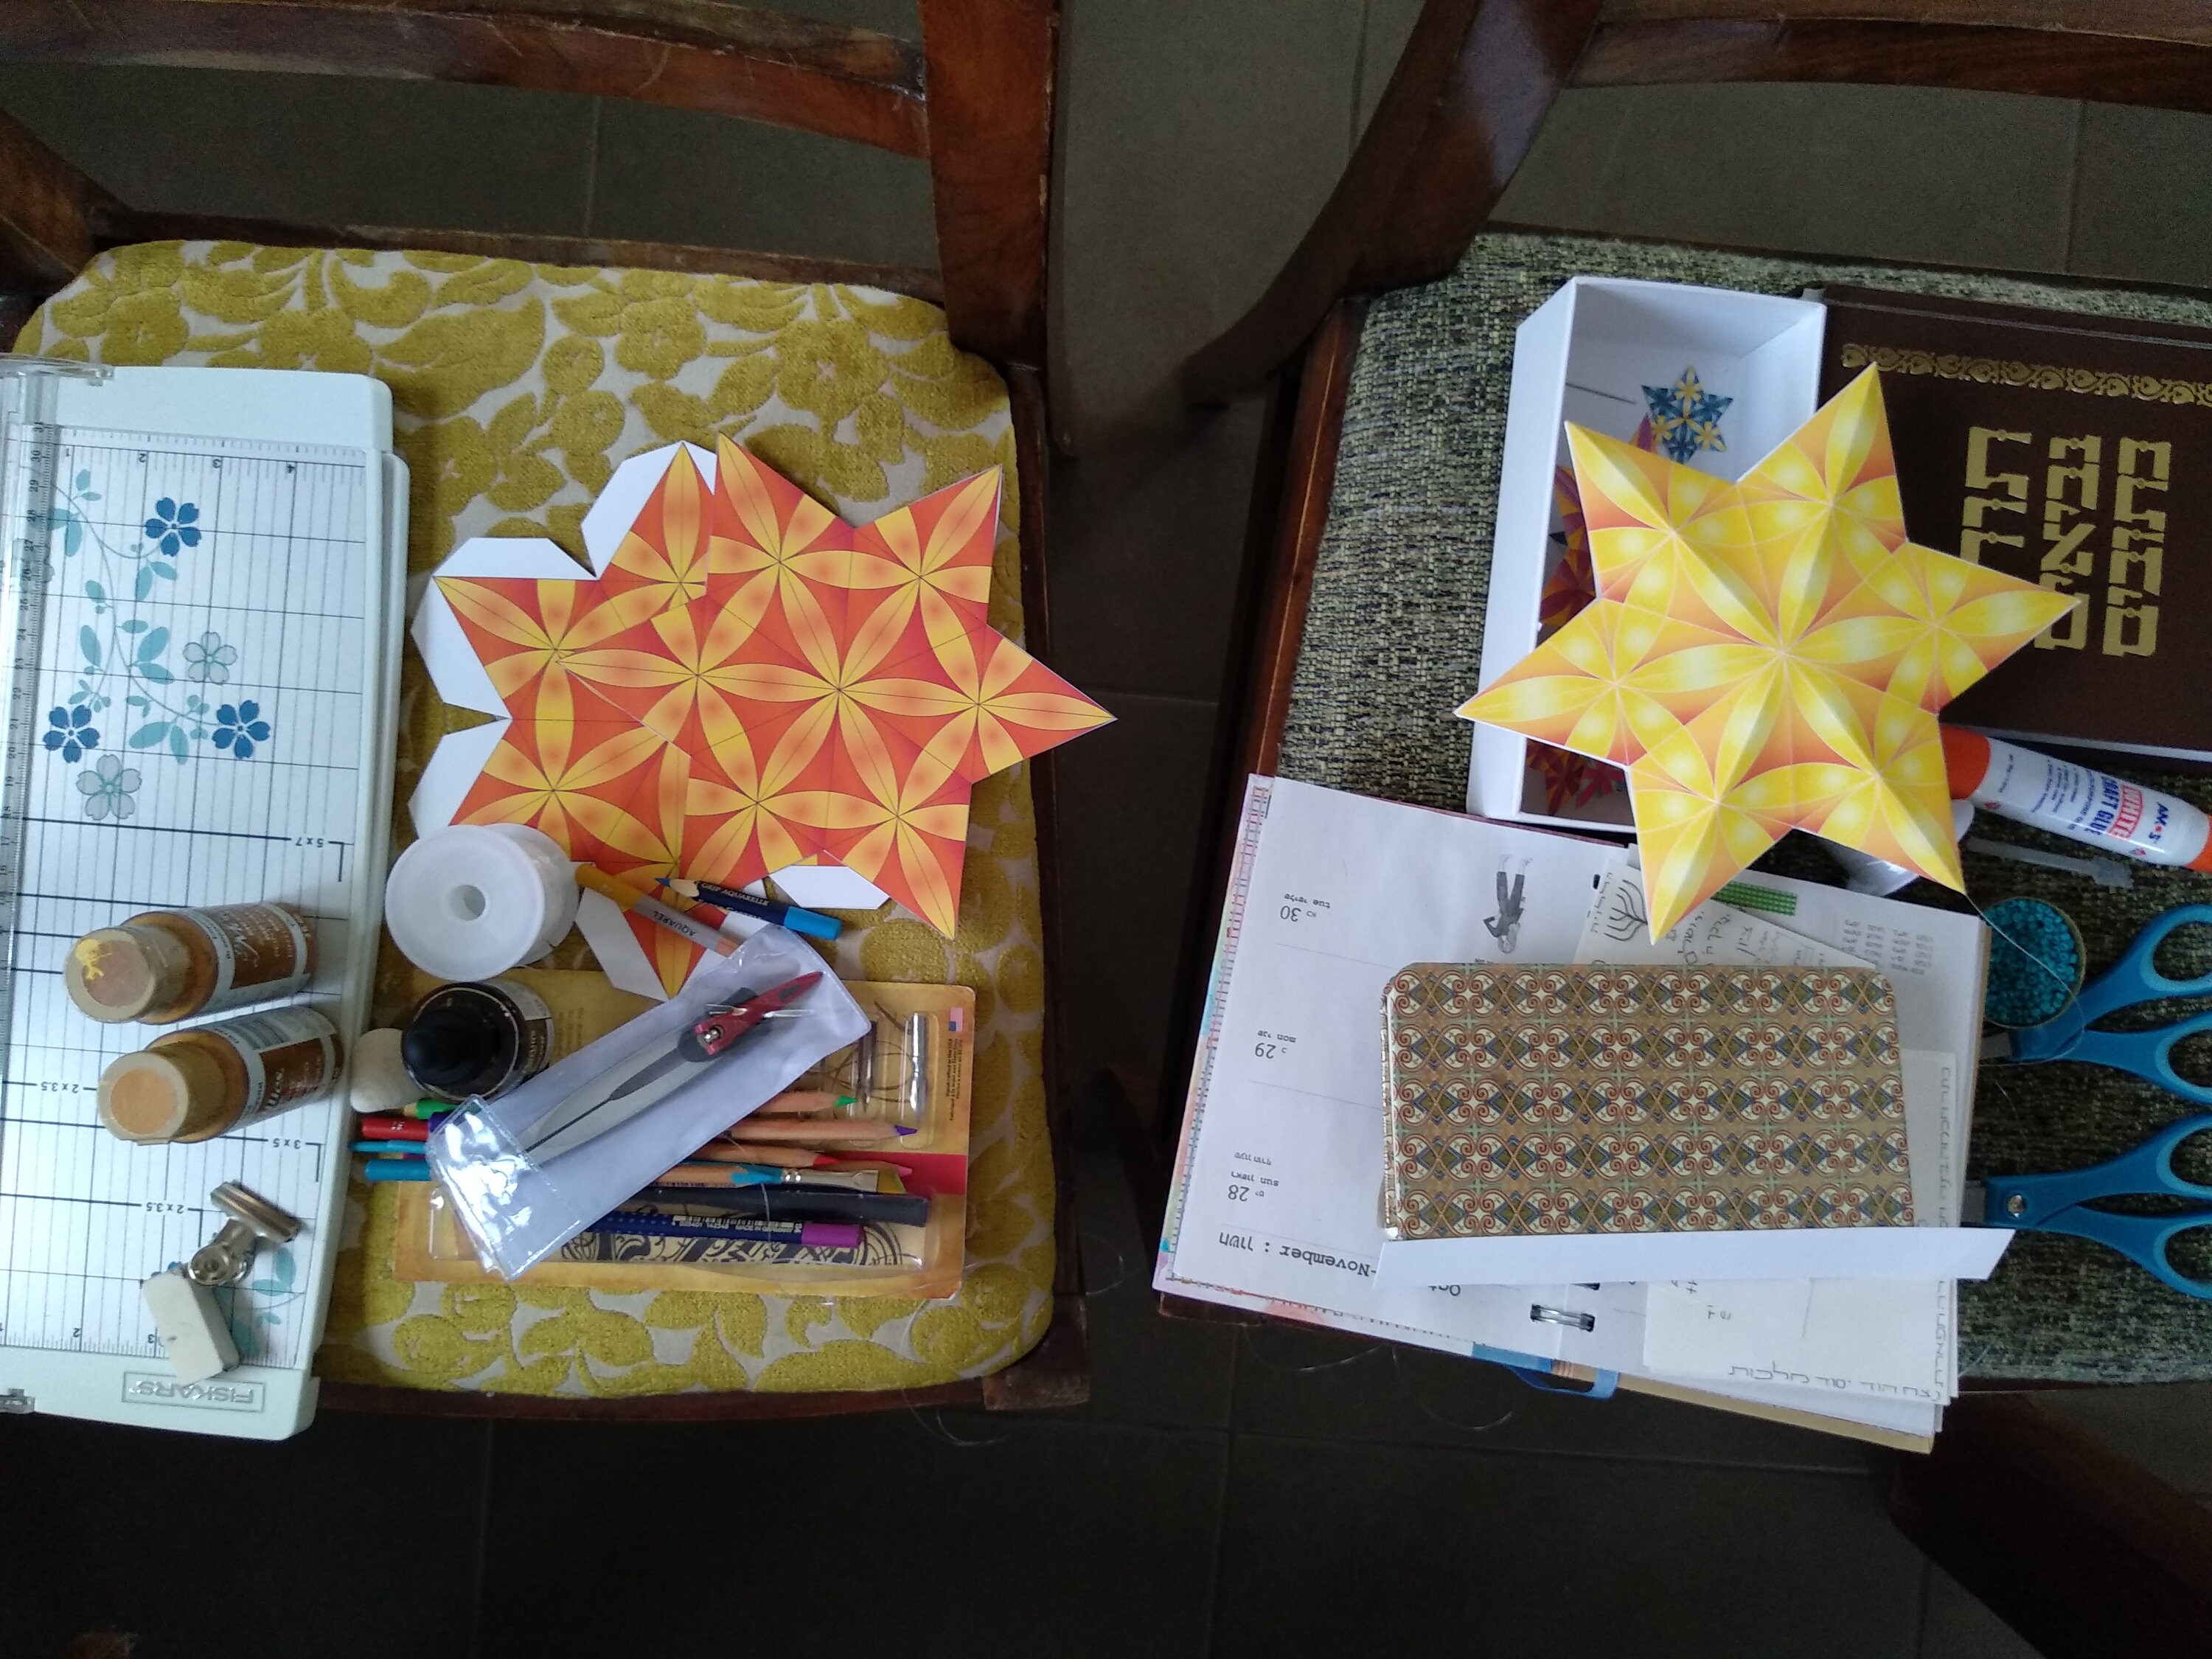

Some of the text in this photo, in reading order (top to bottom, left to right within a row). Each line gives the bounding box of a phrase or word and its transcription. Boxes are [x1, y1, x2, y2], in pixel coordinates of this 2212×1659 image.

[139, 453, 146, 462] 2
[212, 459, 220, 468] 3
[287, 464, 296, 473] 4
[1961, 425, 2032, 566] תור
[2034, 434, 2101, 651] נביאים
[2102, 436, 2172, 657] כתובים
[1312, 899, 1330, 909] tue
[1280, 905, 1301, 922] 30
[653, 911, 697, 936] AQUAREL
[1277, 1034, 1296, 1043] mon
[1255, 1042, 1276, 1060] 29
[1260, 1178, 1279, 1186] sun
[1228, 1184, 1249, 1202] 28
[1219, 1232, 1253, 1251] חשון
[72, 1327, 81, 1337] 2
[147, 1334, 155, 1343] 3
[133, 1380, 254, 1404] FISKARS
